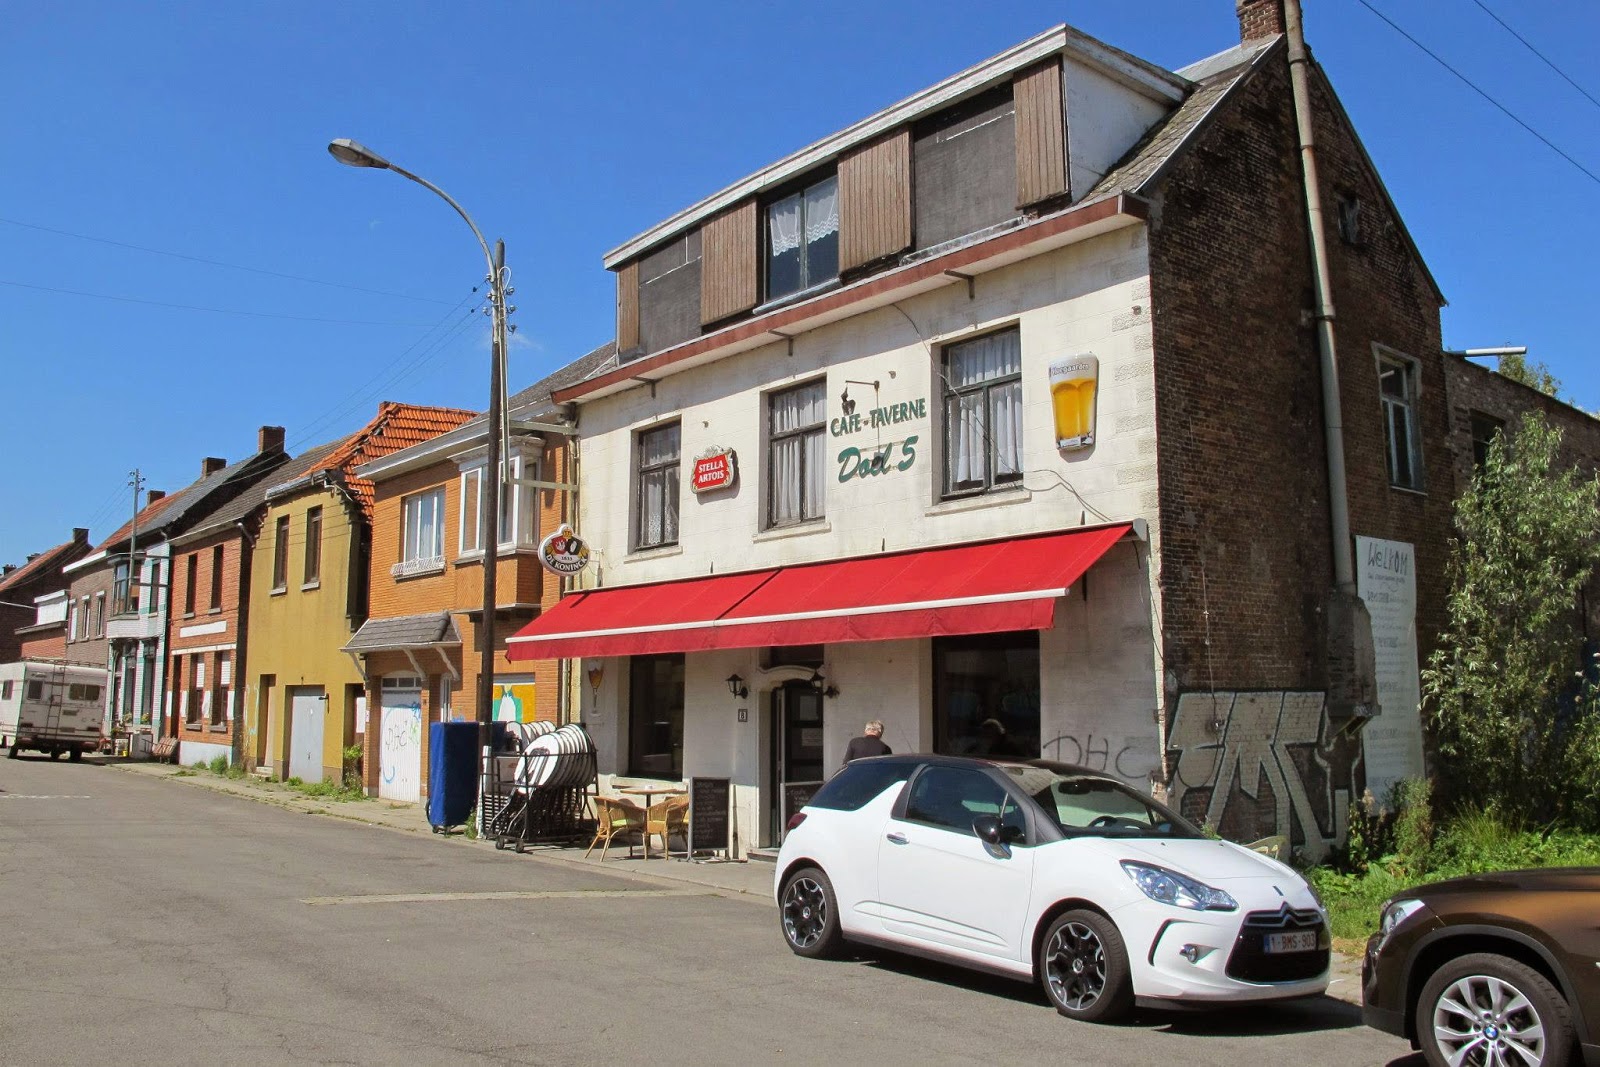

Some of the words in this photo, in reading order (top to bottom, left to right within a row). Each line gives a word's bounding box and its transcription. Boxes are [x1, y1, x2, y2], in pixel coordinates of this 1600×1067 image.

[898, 435, 919, 472] 5
[698, 459, 724, 473] STELLA
[698, 470, 725, 483] ARTOIS
[546, 554, 555, 565] DE
[554, 557, 588, 571] KONINCK
[1043, 730, 1147, 779] DHC
